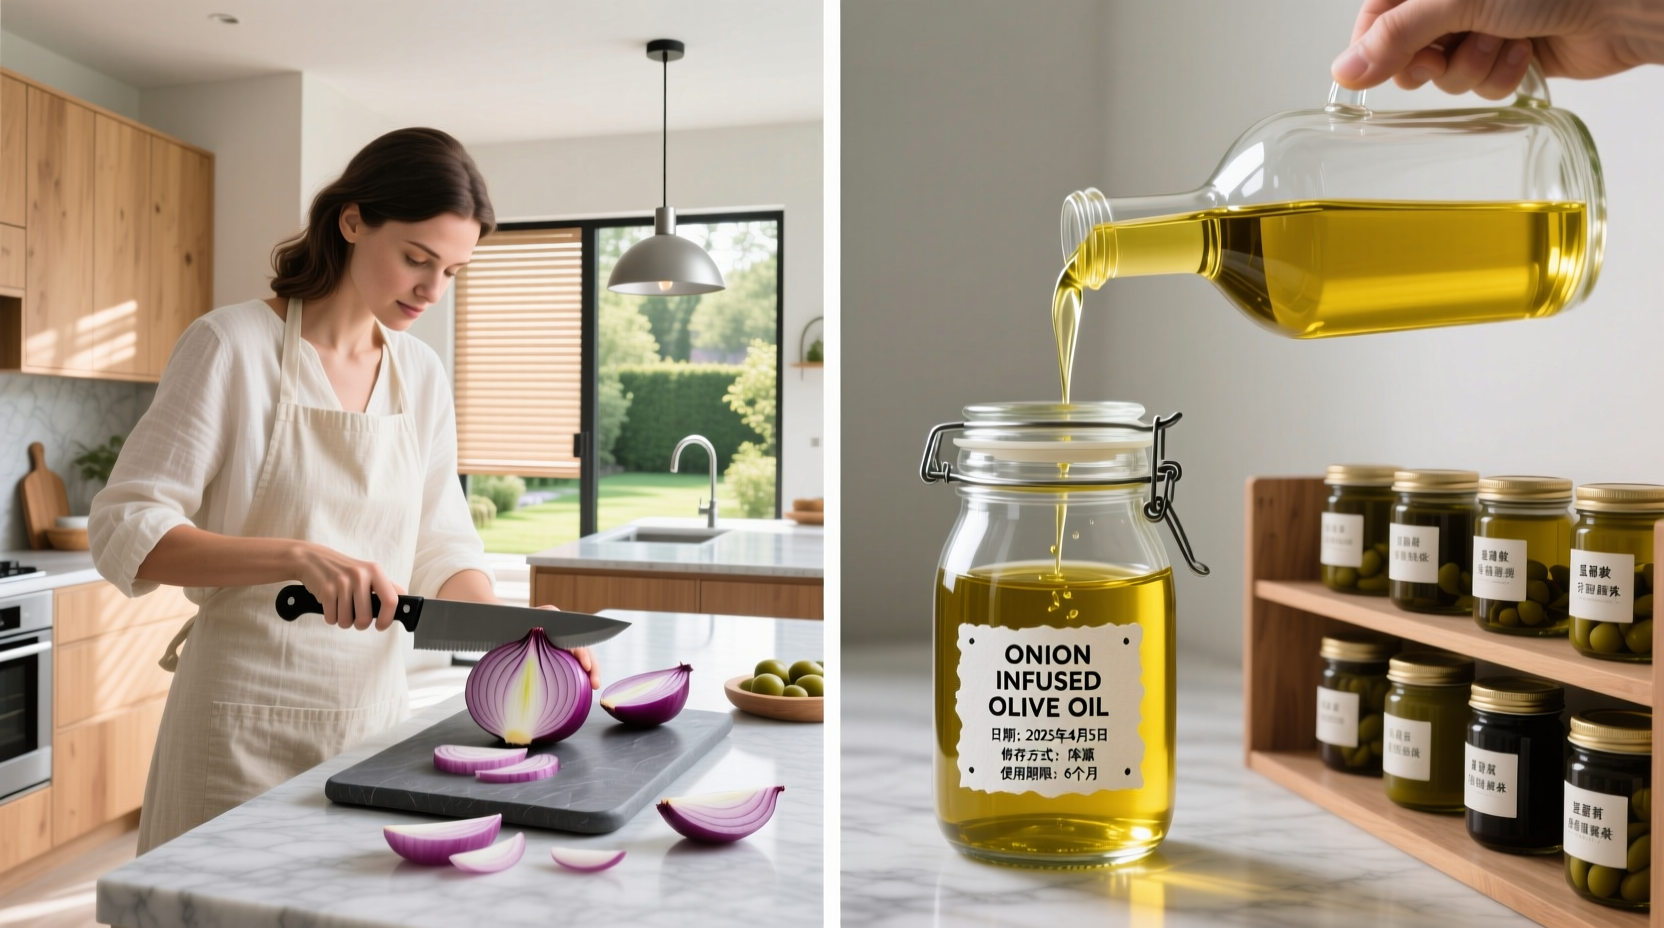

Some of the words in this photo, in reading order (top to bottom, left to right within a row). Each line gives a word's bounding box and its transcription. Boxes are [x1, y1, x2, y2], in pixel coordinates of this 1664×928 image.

[1005, 644, 1091, 665] ONION
[996, 670, 1102, 691] INFUSED
[989, 696, 1060, 717] OLIVE
[1068, 696, 1109, 717] OIL
